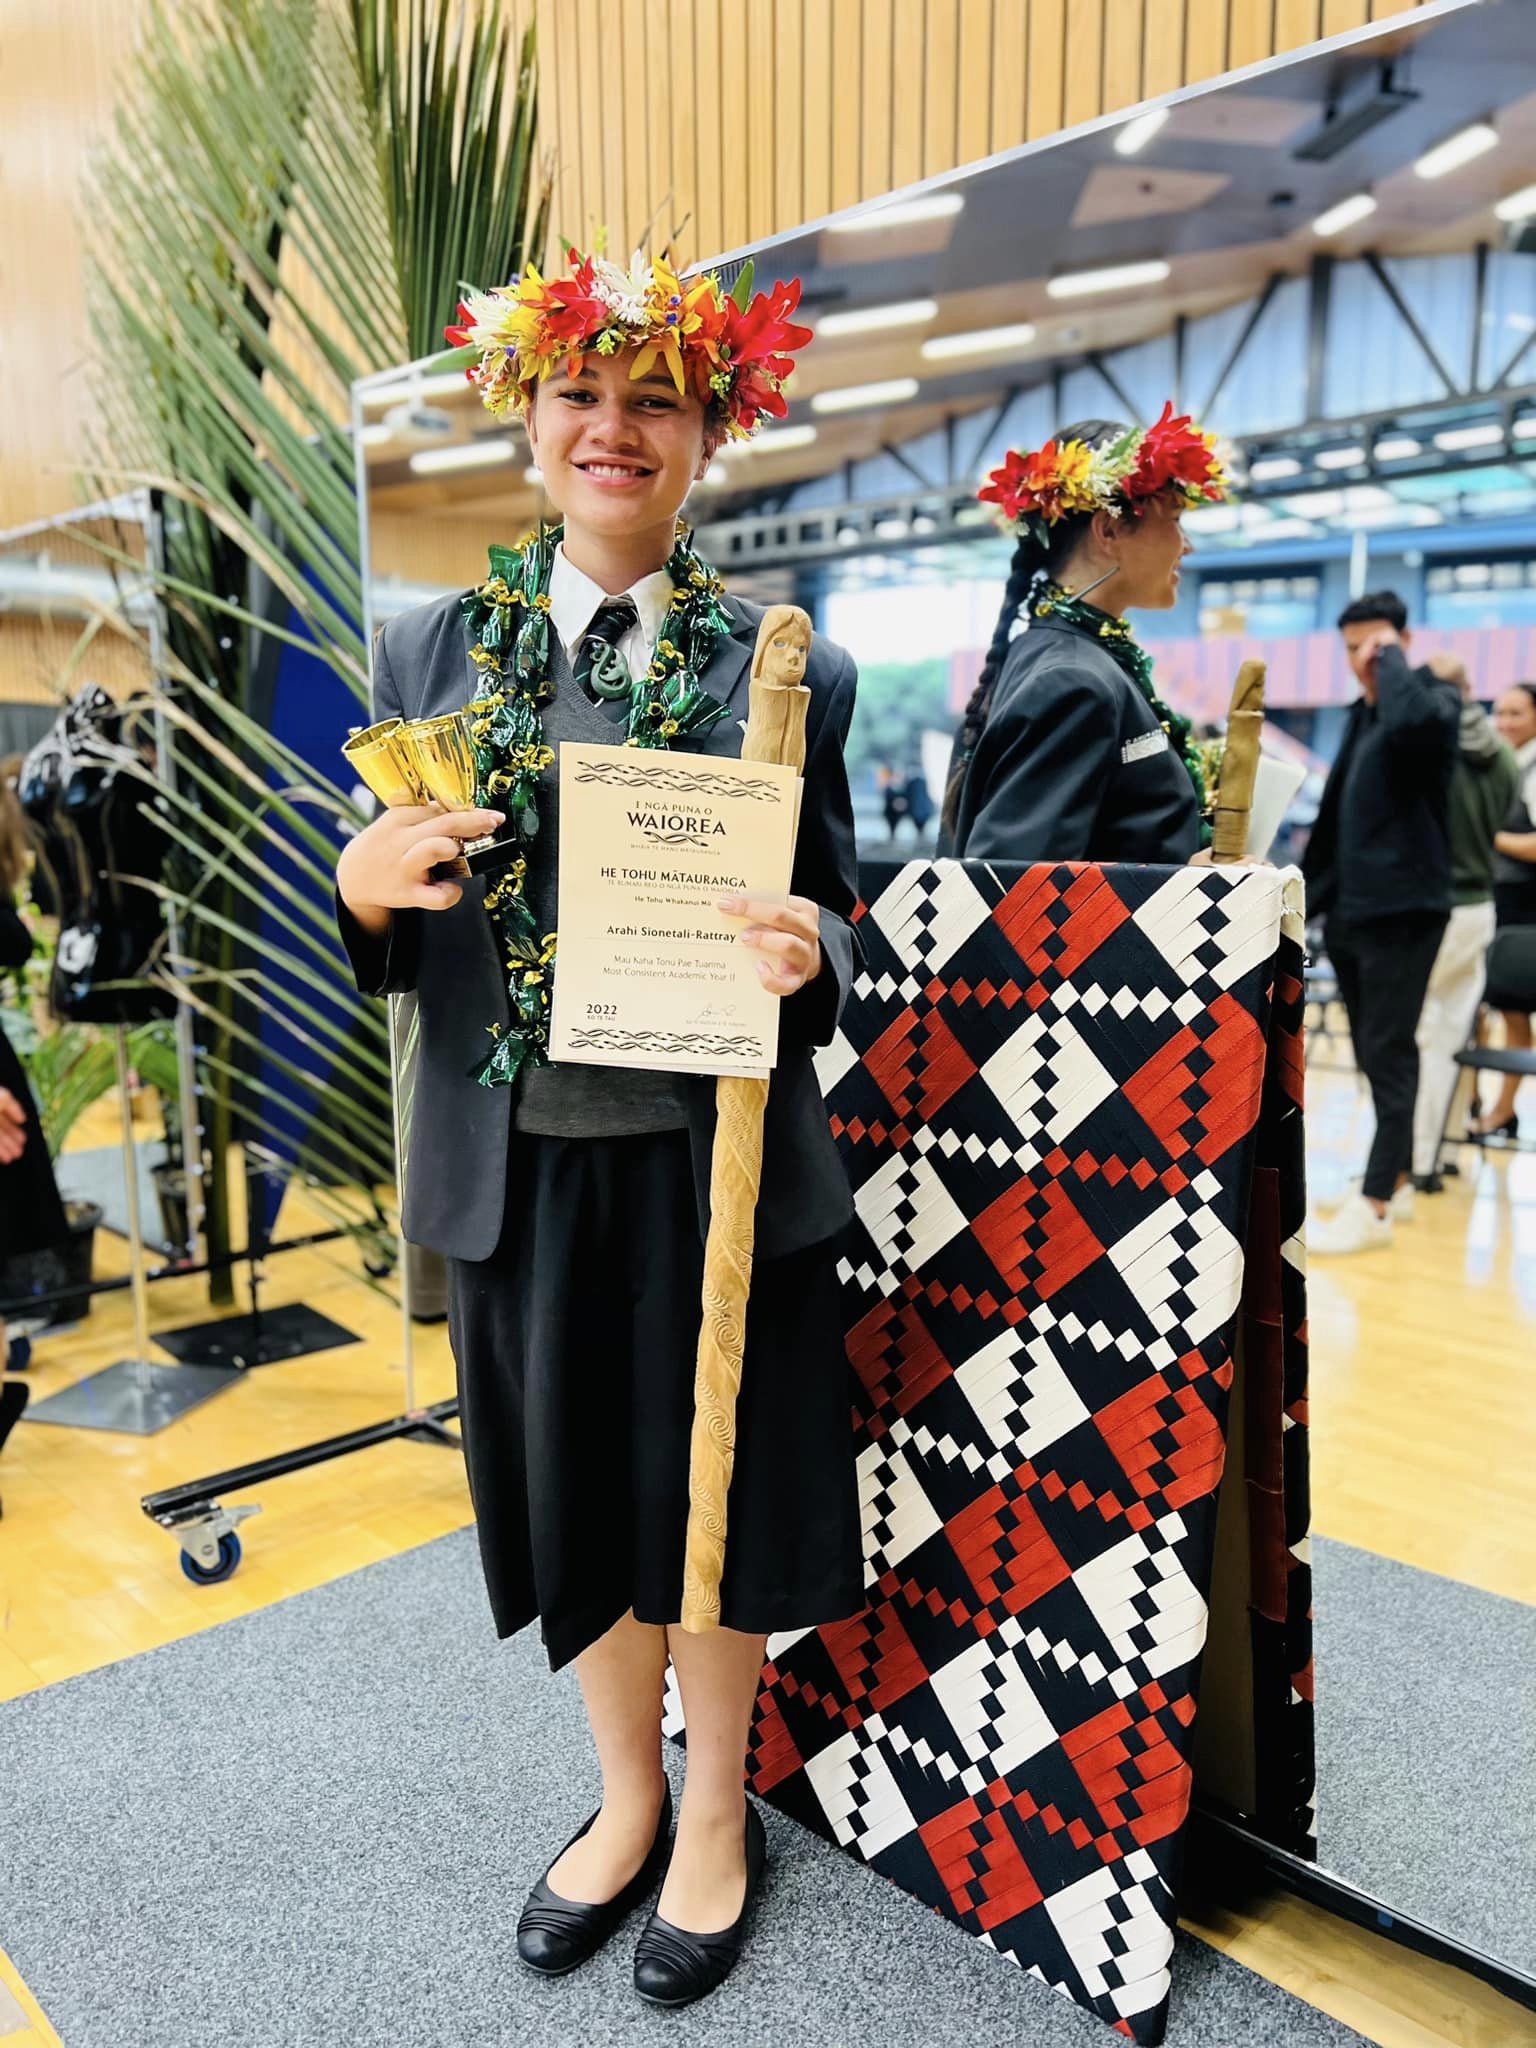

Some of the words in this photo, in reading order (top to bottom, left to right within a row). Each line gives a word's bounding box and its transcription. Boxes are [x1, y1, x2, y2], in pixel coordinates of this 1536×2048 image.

[672, 804, 701, 815] PUNA
[704, 807, 713, 815] O
[600, 867, 617, 878] HE
[621, 868, 657, 881] TOHU
[660, 869, 747, 888] MĀTAURANGA
[607, 925, 637, 936] Arahi
[641, 926, 736, 943] Sionetali-Rattray
[614, 955, 631, 964] Mau
[656, 957, 676, 966] Tonu
[678, 958, 692, 967] Pae
[603, 967, 621, 976] Most
[624, 968, 666, 978] Consistent
[668, 970, 706, 980] Academic
[709, 972, 727, 981] Year
[586, 1003, 617, 1015] 2022
